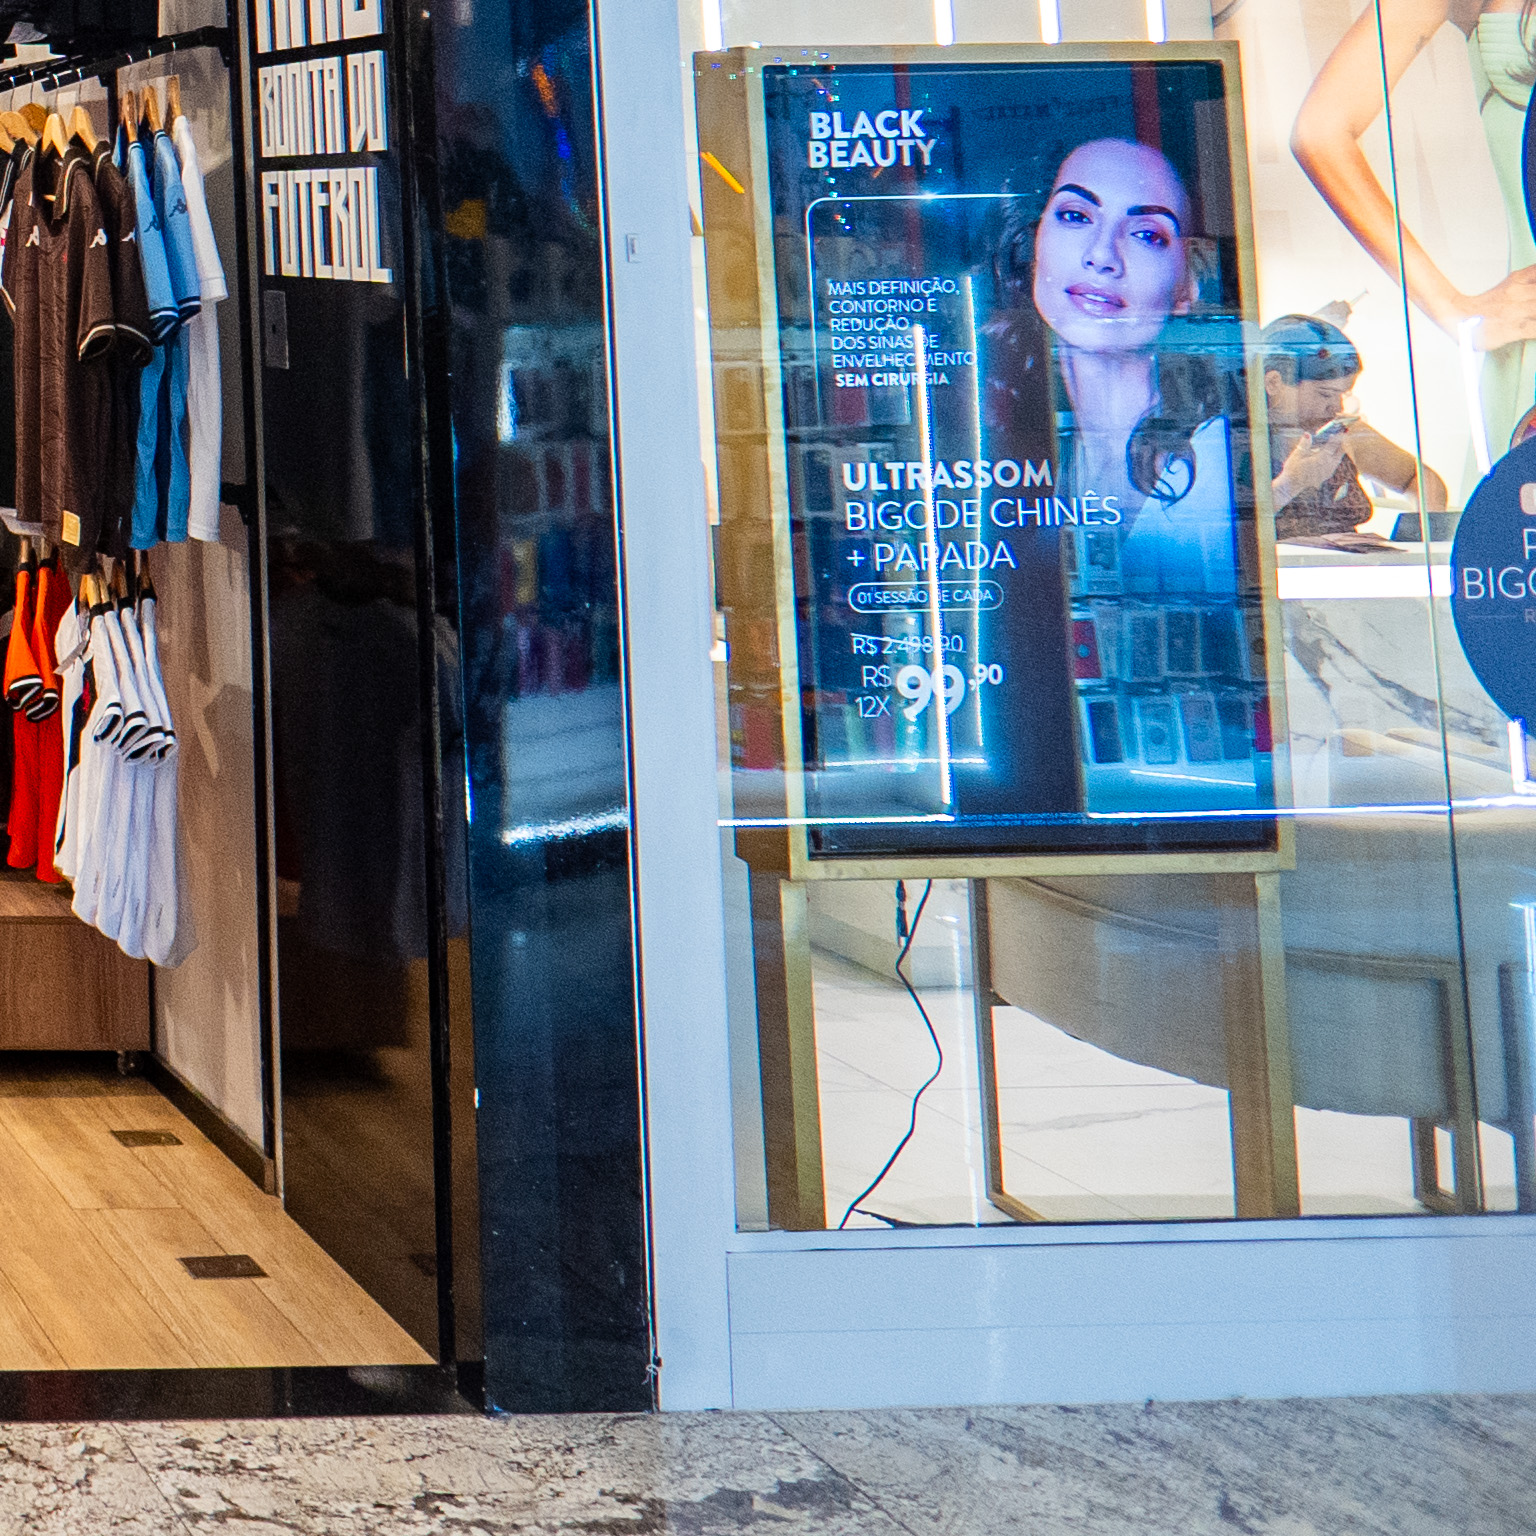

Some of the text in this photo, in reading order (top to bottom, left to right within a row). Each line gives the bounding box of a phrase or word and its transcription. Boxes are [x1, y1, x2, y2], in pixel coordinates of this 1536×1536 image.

[258, 50, 388, 158] BONITA DO
[810, 110, 927, 139] BLACK
[808, 138, 938, 168] BEAUTY
[261, 166, 393, 284] FUTEBOL
[828, 276, 960, 297] MAIS DEFINIÇÃO,
[829, 298, 937, 314] CONTORNO E
[830, 314, 909, 335] REDUÇÃO
[831, 335, 866, 351] DOS
[832, 351, 976, 369] ENVELHECMENTO
[835, 372, 870, 388] SEM
[842, 459, 1054, 492] ULTRASSOM
[845, 490, 1122, 531] BIGODE CHINÊS
[873, 587, 928, 604] SESSÃO
[952, 589, 994, 603] CADA
[881, 635, 964, 655] 2.49890
[861, 665, 892, 689] R$
[855, 694, 892, 718] 12X
